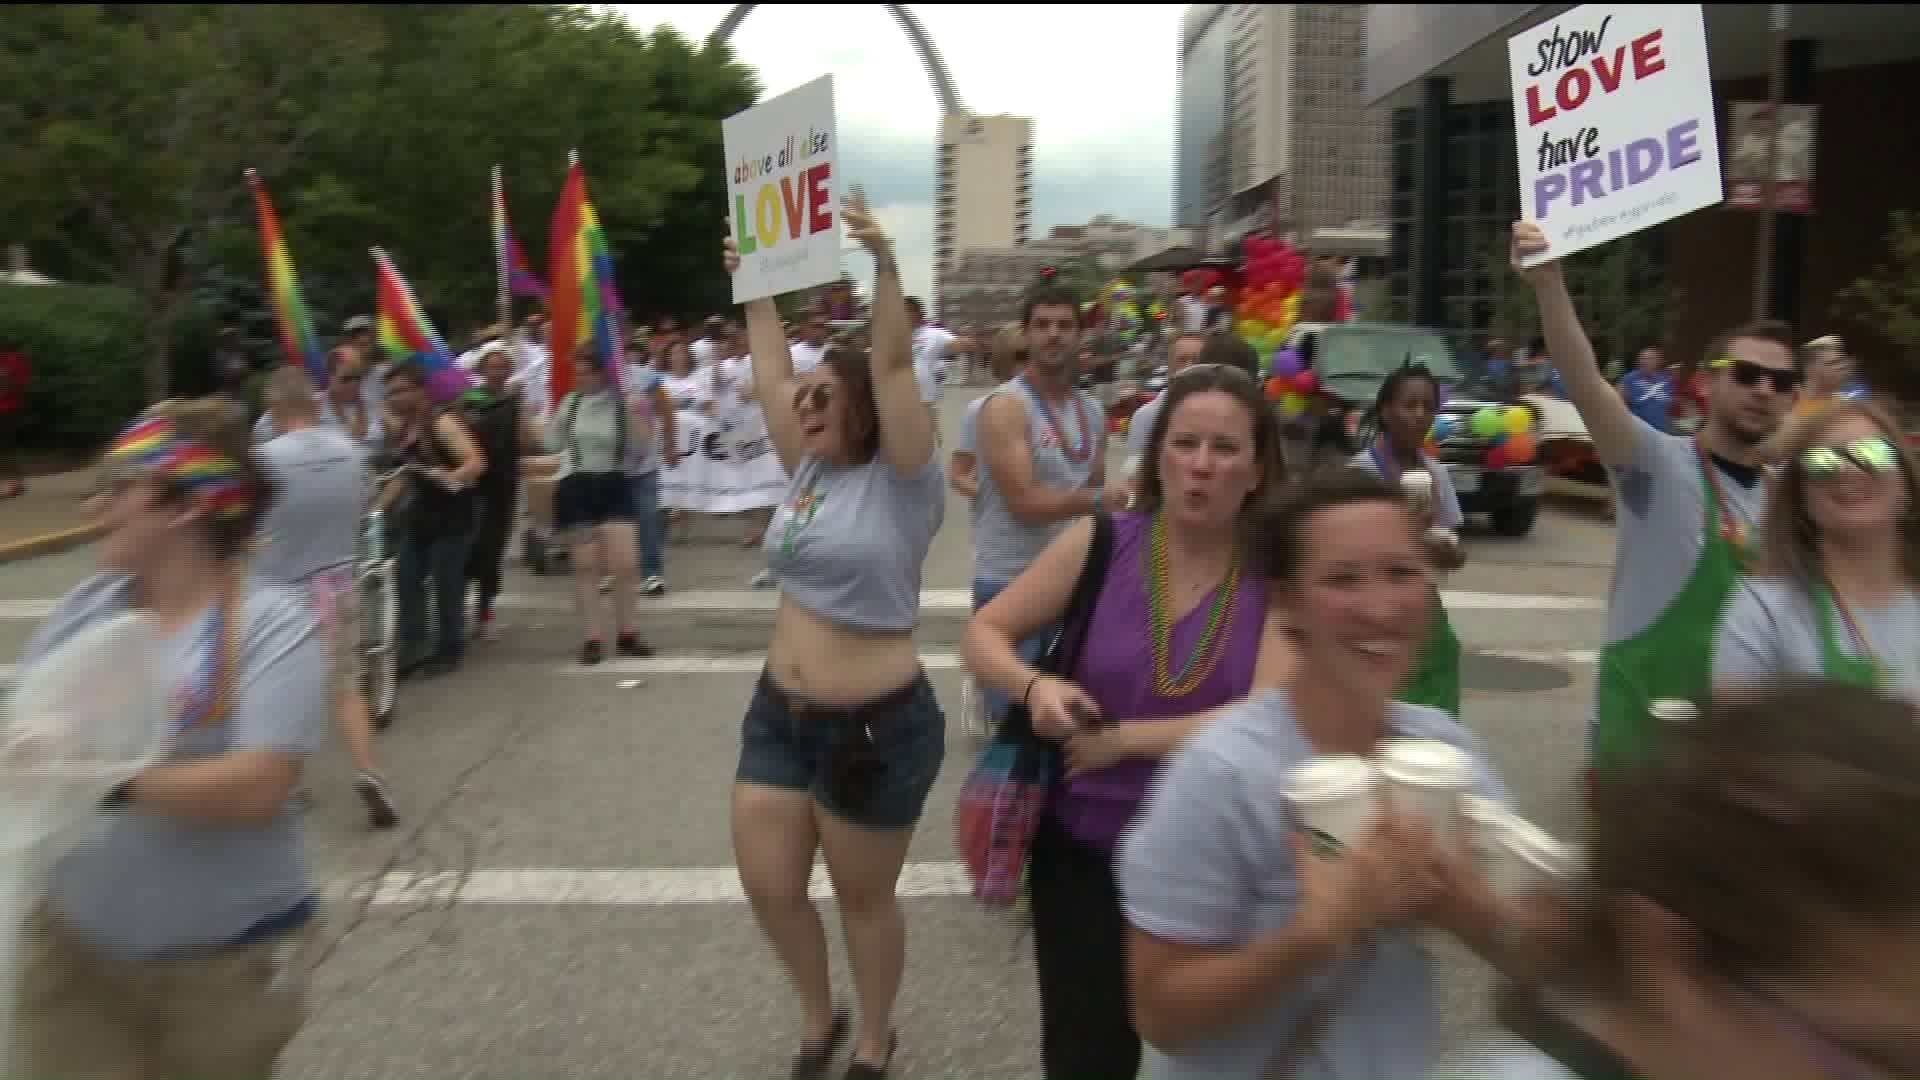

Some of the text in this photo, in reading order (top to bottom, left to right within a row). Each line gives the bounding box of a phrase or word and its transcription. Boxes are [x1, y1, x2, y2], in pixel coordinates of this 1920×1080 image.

[1525, 28, 1666, 127] LOVE
[1527, 14, 1612, 77] show
[734, 126, 829, 185] above all else
[1534, 119, 1702, 219] PRIDE
[1537, 127, 1600, 173] have
[735, 161, 833, 255] LOVE
